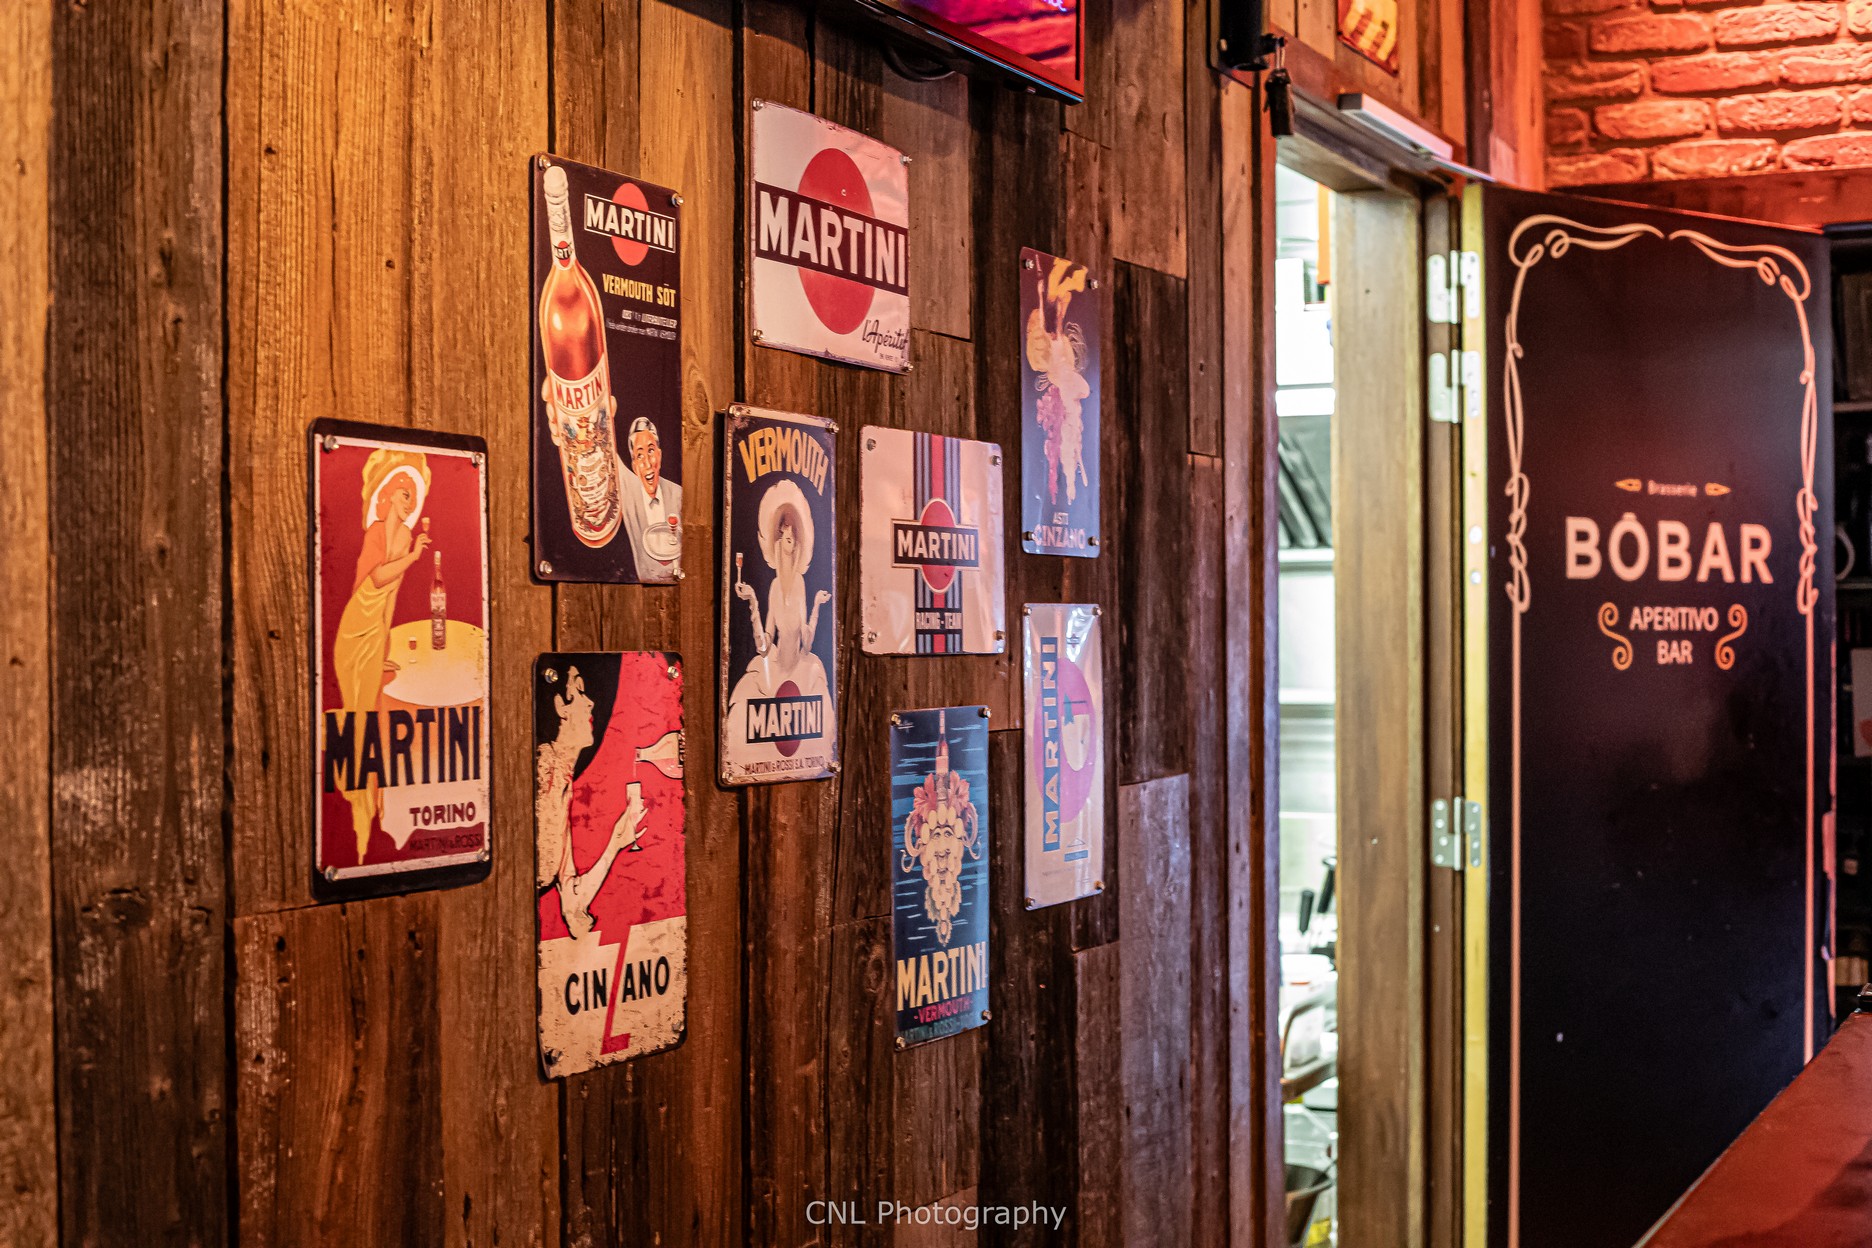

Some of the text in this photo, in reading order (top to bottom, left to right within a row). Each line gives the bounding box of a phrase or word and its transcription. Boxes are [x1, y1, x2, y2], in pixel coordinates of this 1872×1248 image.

[586, 198, 674, 249] MARTINI
[759, 190, 906, 288] MARTINI
[602, 273, 653, 303] VERMOUTH
[738, 426, 829, 497] VERMOUTH
[897, 529, 976, 561] MARTINI
[1629, 606, 1719, 631] APERITIVO
[1656, 639, 1693, 665] BAR
[748, 701, 822, 740] MARTINI
[324, 705, 481, 793] MARTINI
[1042, 643, 1060, 845] MARTINI
[409, 801, 476, 827] TORINO
[896, 941, 988, 1012] MARTINI
